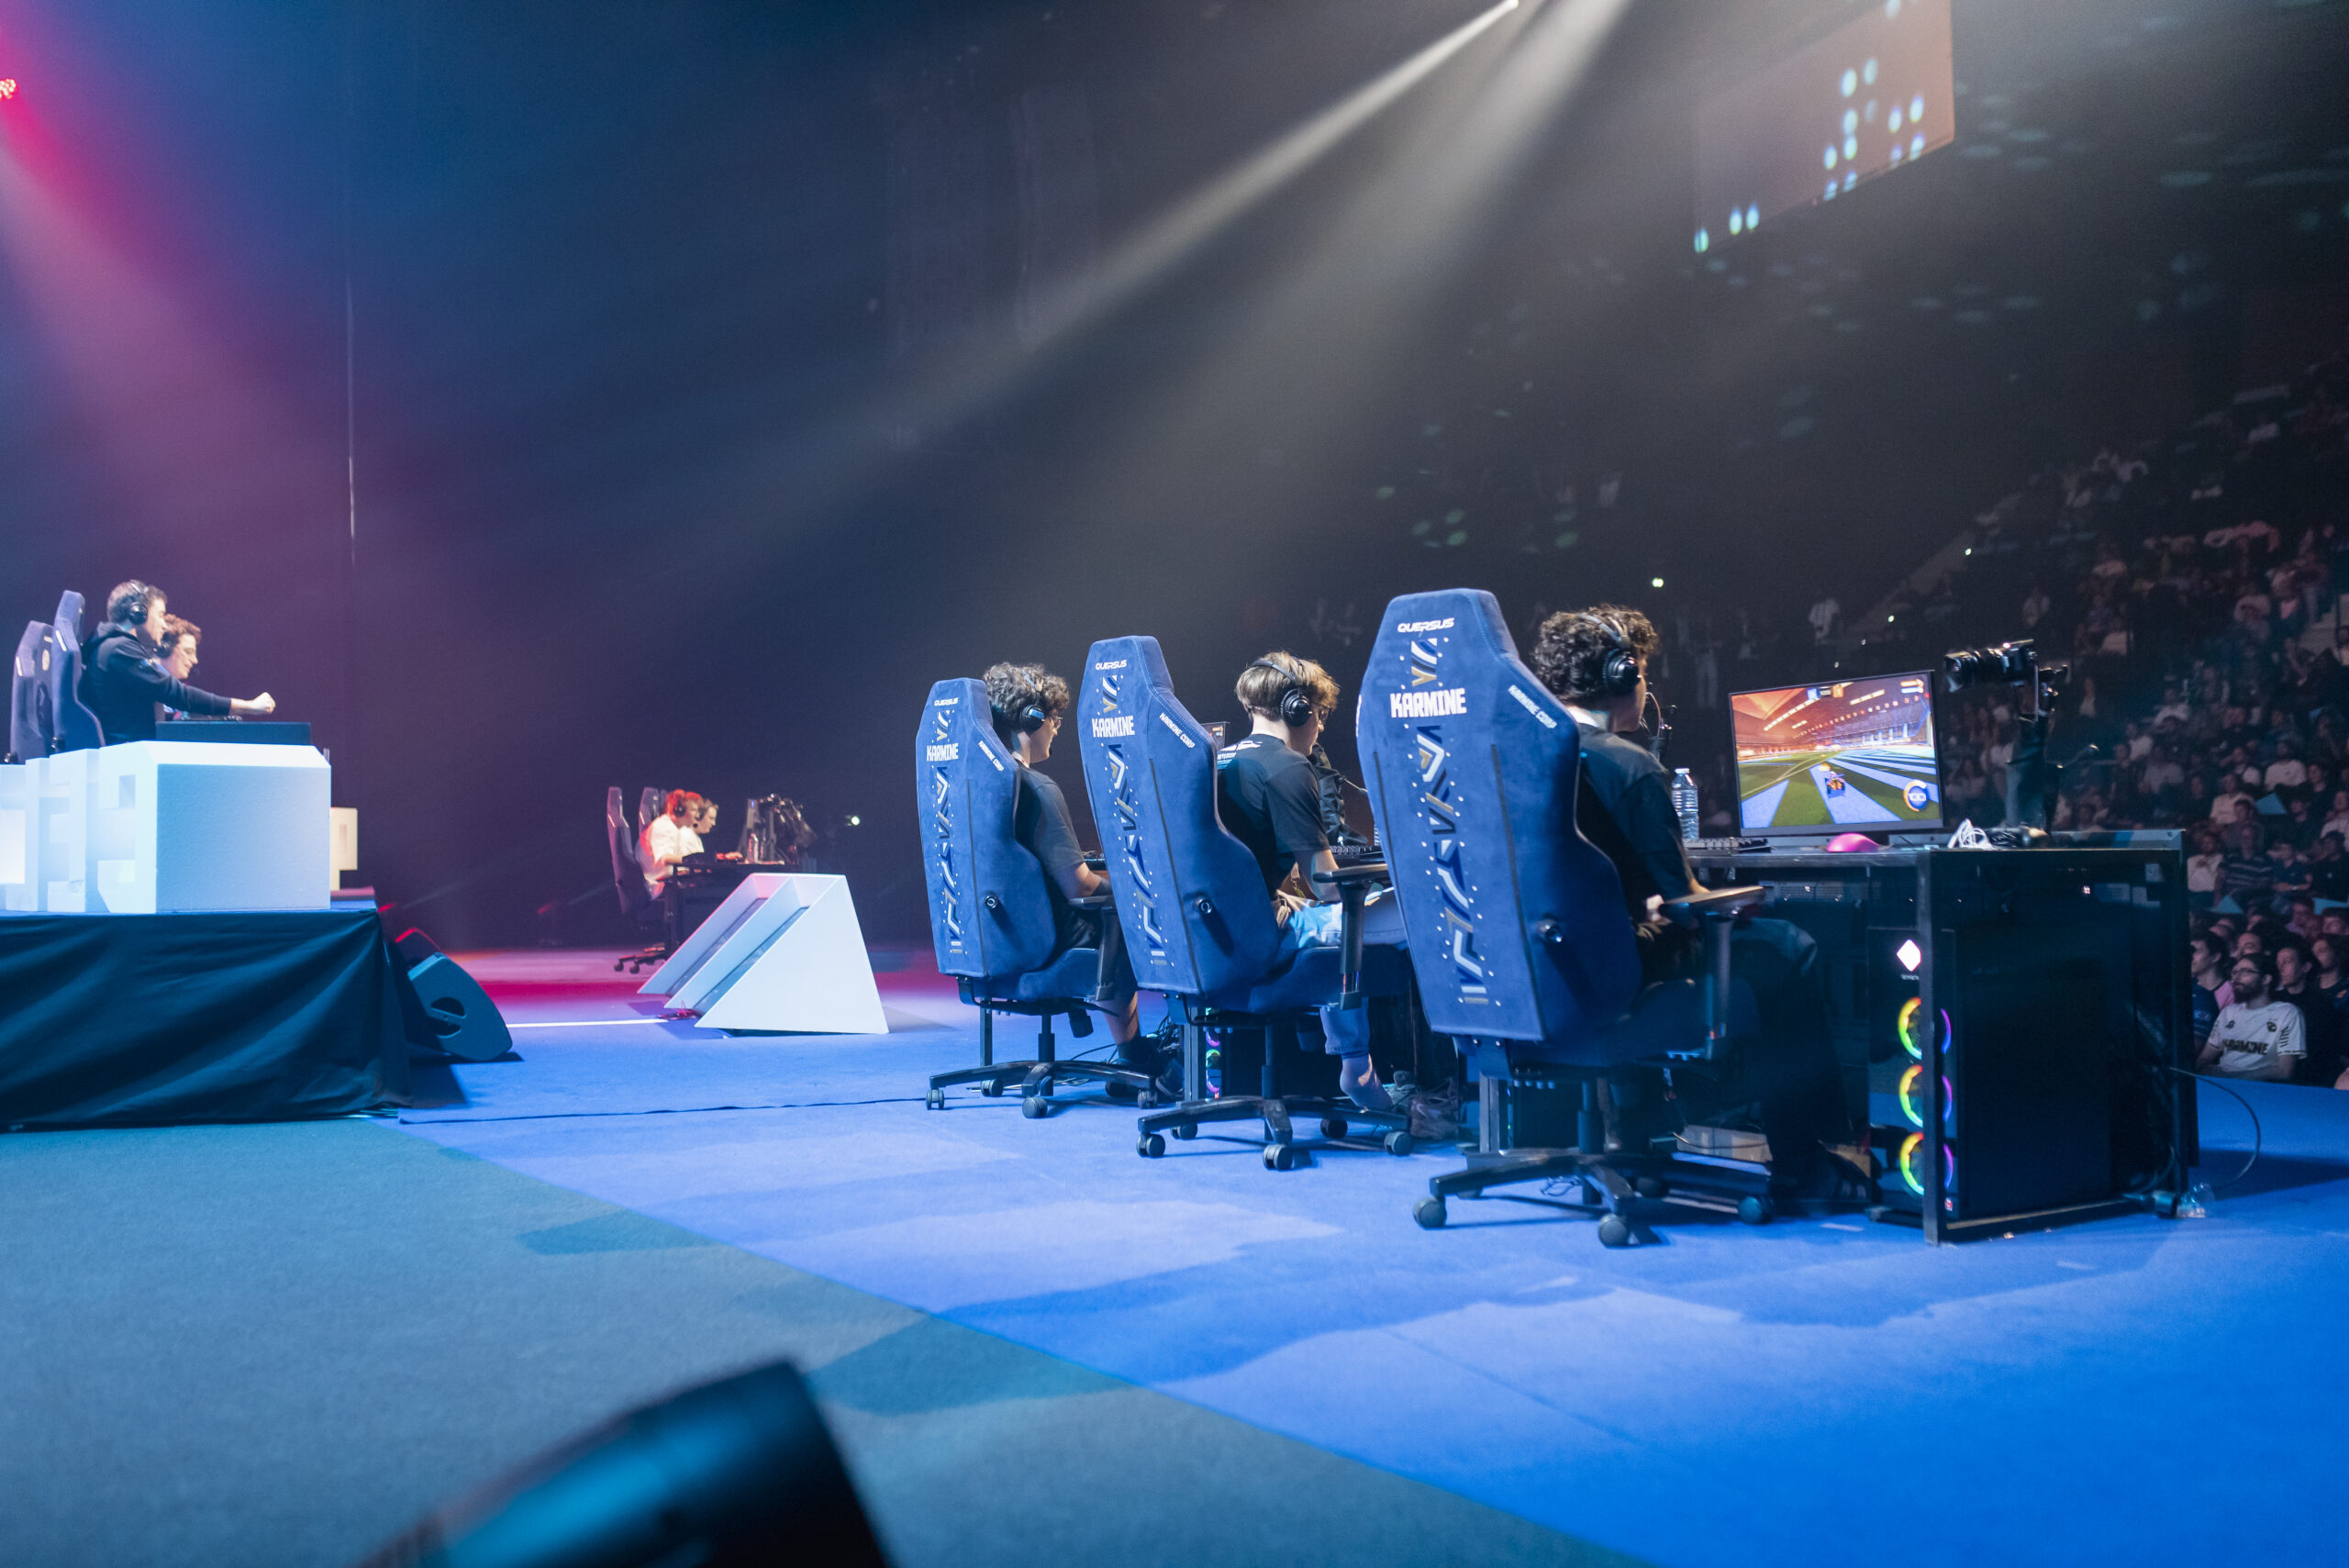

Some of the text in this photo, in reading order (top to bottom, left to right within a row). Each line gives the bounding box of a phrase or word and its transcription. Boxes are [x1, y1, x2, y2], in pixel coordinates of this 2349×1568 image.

[1397, 617, 1455, 633] QUERSUS
[1095, 660, 1128, 671] QUERSUS
[1389, 688, 1467, 717] KARMINE
[1091, 716, 1136, 738] KARMINE
[1159, 712, 1183, 737] KARMINE
[1179, 733, 1196, 749] CORP
[926, 742, 959, 762] KARMINE
